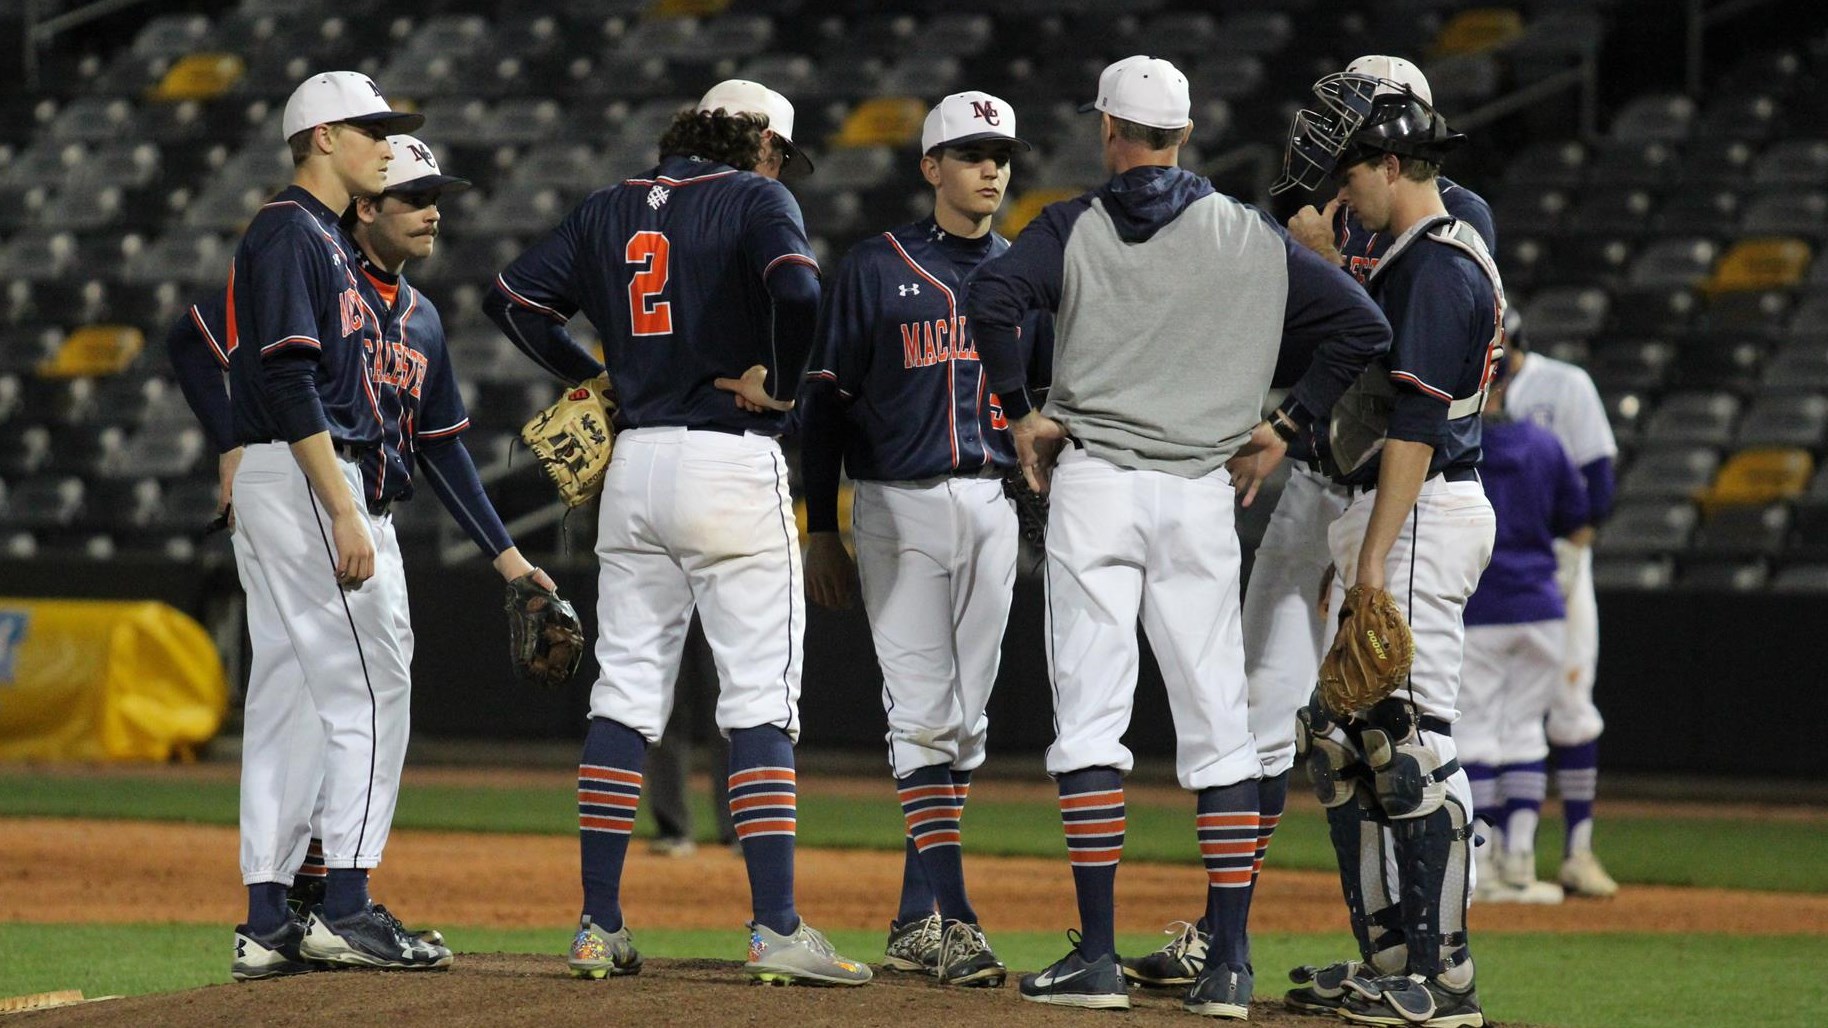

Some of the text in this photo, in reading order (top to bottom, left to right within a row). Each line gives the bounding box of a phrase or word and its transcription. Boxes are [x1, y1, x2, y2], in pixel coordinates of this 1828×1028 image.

[970, 100, 1000, 127] MC
[625, 230, 673, 337] 2
[1366, 630, 1388, 660] A2000
